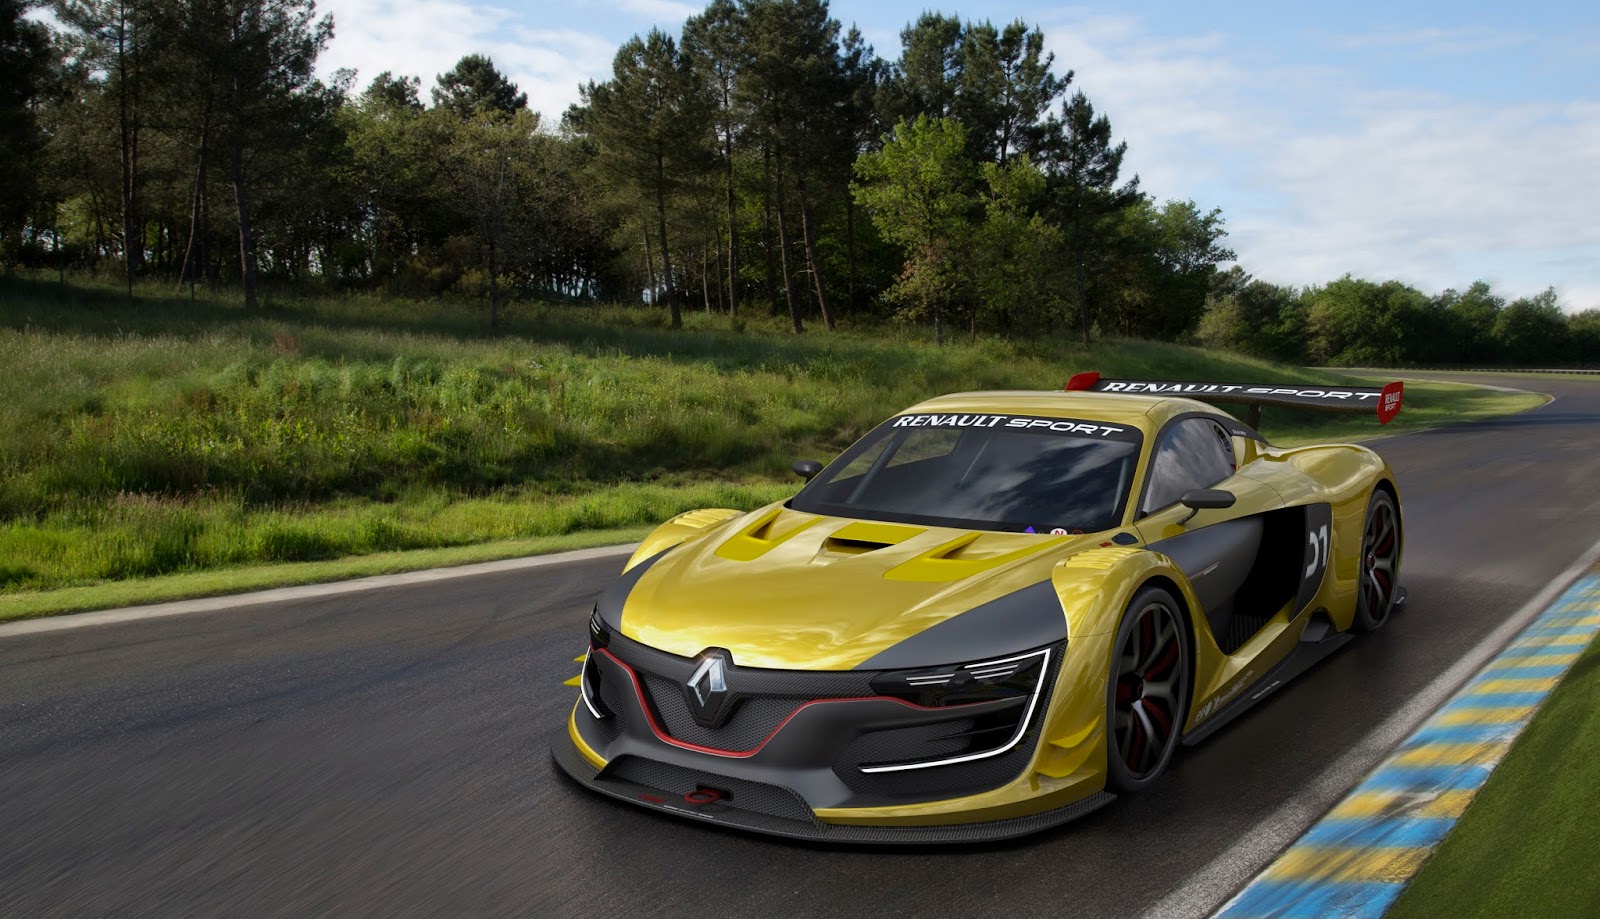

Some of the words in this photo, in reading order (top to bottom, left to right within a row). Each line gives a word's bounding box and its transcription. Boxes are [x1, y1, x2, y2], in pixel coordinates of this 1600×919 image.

[1101, 382, 1243, 393] RENAULT
[1241, 388, 1382, 400] SPORT
[893, 415, 1008, 428] RENAULT
[1004, 418, 1124, 437] SPORT
